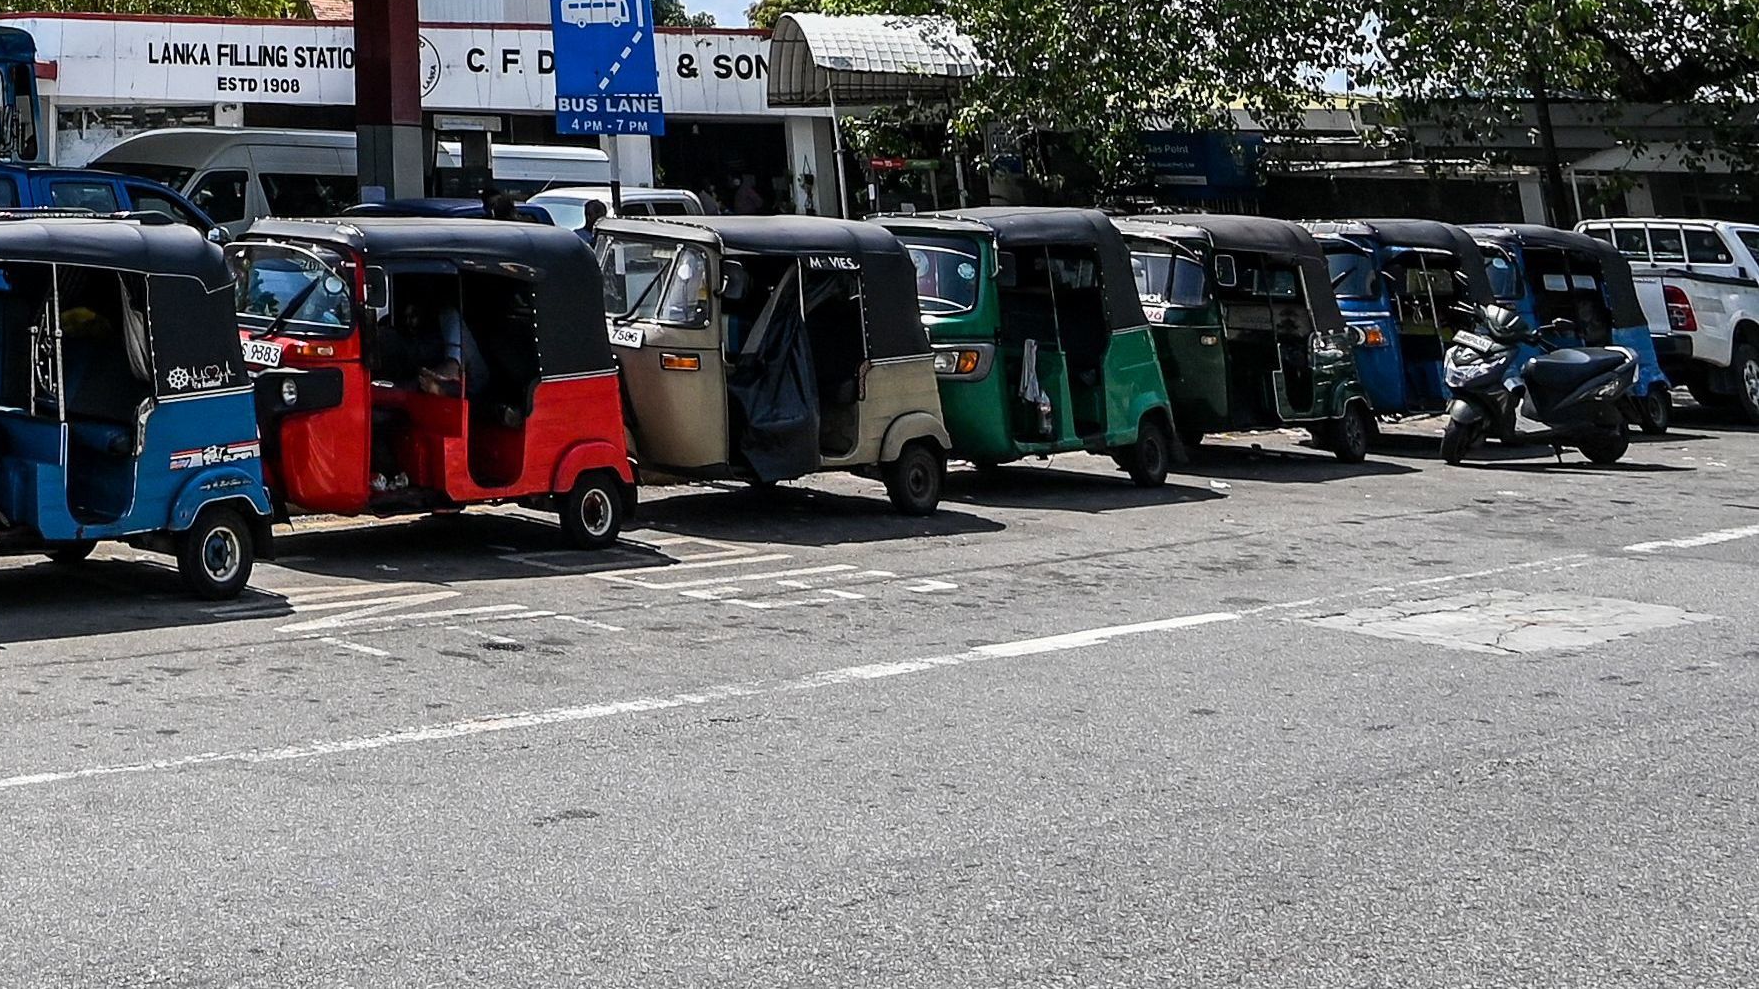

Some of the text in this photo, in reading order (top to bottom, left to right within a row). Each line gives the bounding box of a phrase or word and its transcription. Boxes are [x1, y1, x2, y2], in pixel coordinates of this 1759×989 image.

[148, 42, 356, 69] LANKA FILLING STATIO
[466, 47, 490, 74] C.
[502, 48, 524, 74] F.
[676, 53, 699, 79] &
[713, 54, 769, 80] SON
[217, 76, 300, 94] ESTD 1908
[558, 97, 660, 113] BUS LANE
[571, 118, 580, 130] 4
[584, 120, 603, 131] PM
[616, 119, 625, 131] 7
[629, 120, 648, 131] PM
